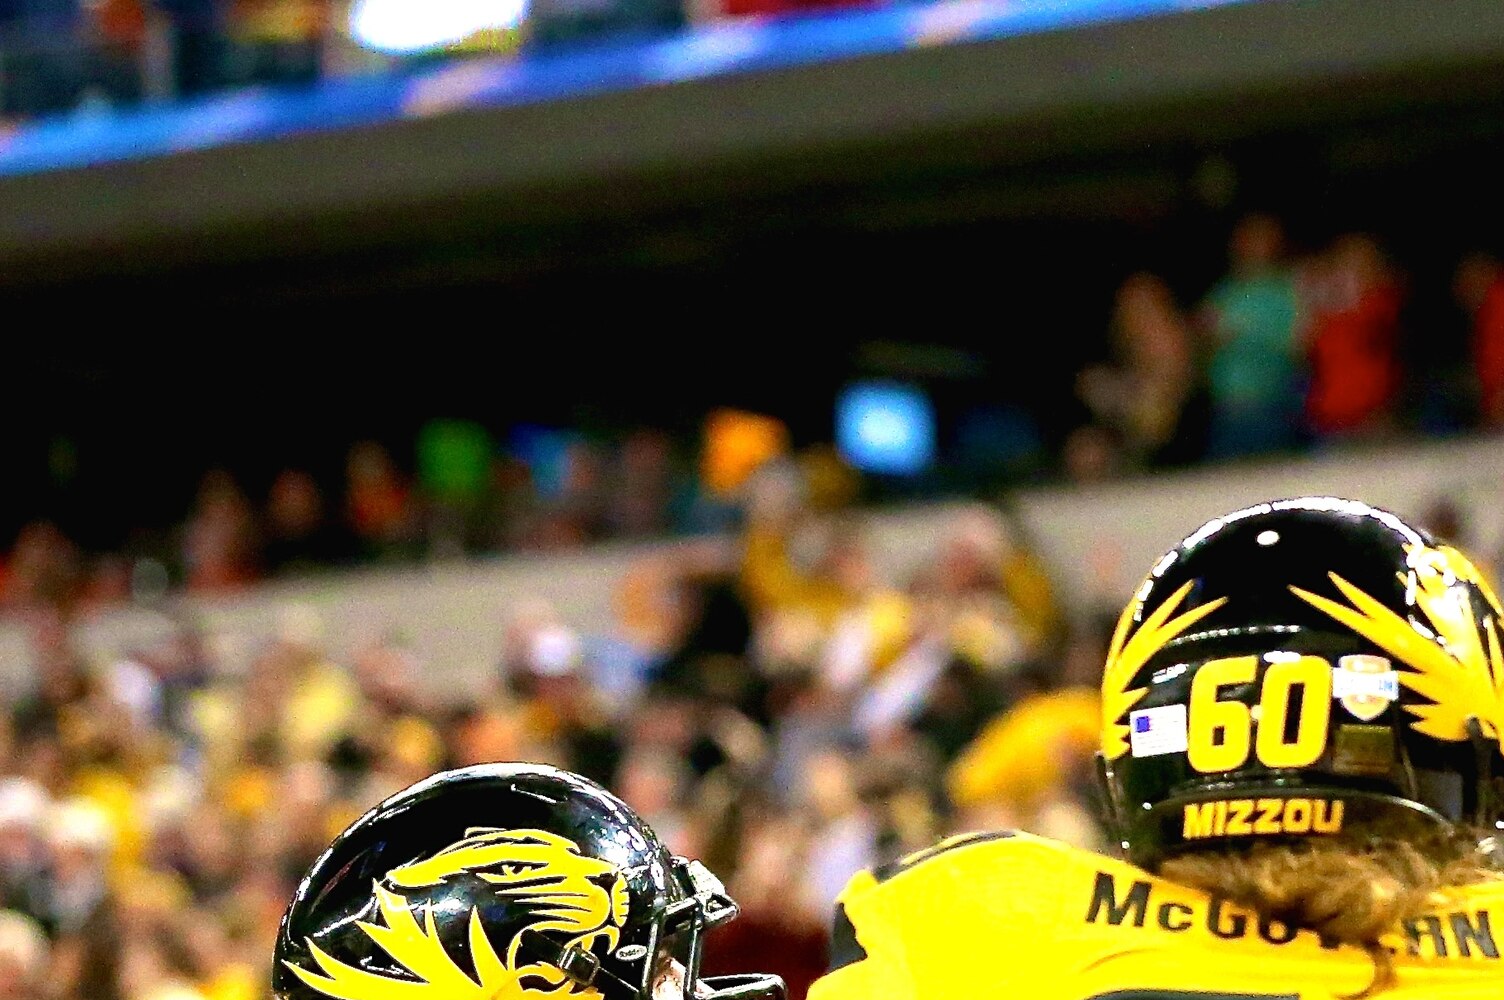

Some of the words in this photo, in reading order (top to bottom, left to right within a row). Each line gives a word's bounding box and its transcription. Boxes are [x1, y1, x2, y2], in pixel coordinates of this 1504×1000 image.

[1187, 655, 1333, 773] 60
[1182, 798, 1344, 840] MIZZOU
[1085, 870, 1502, 959] McGORN
